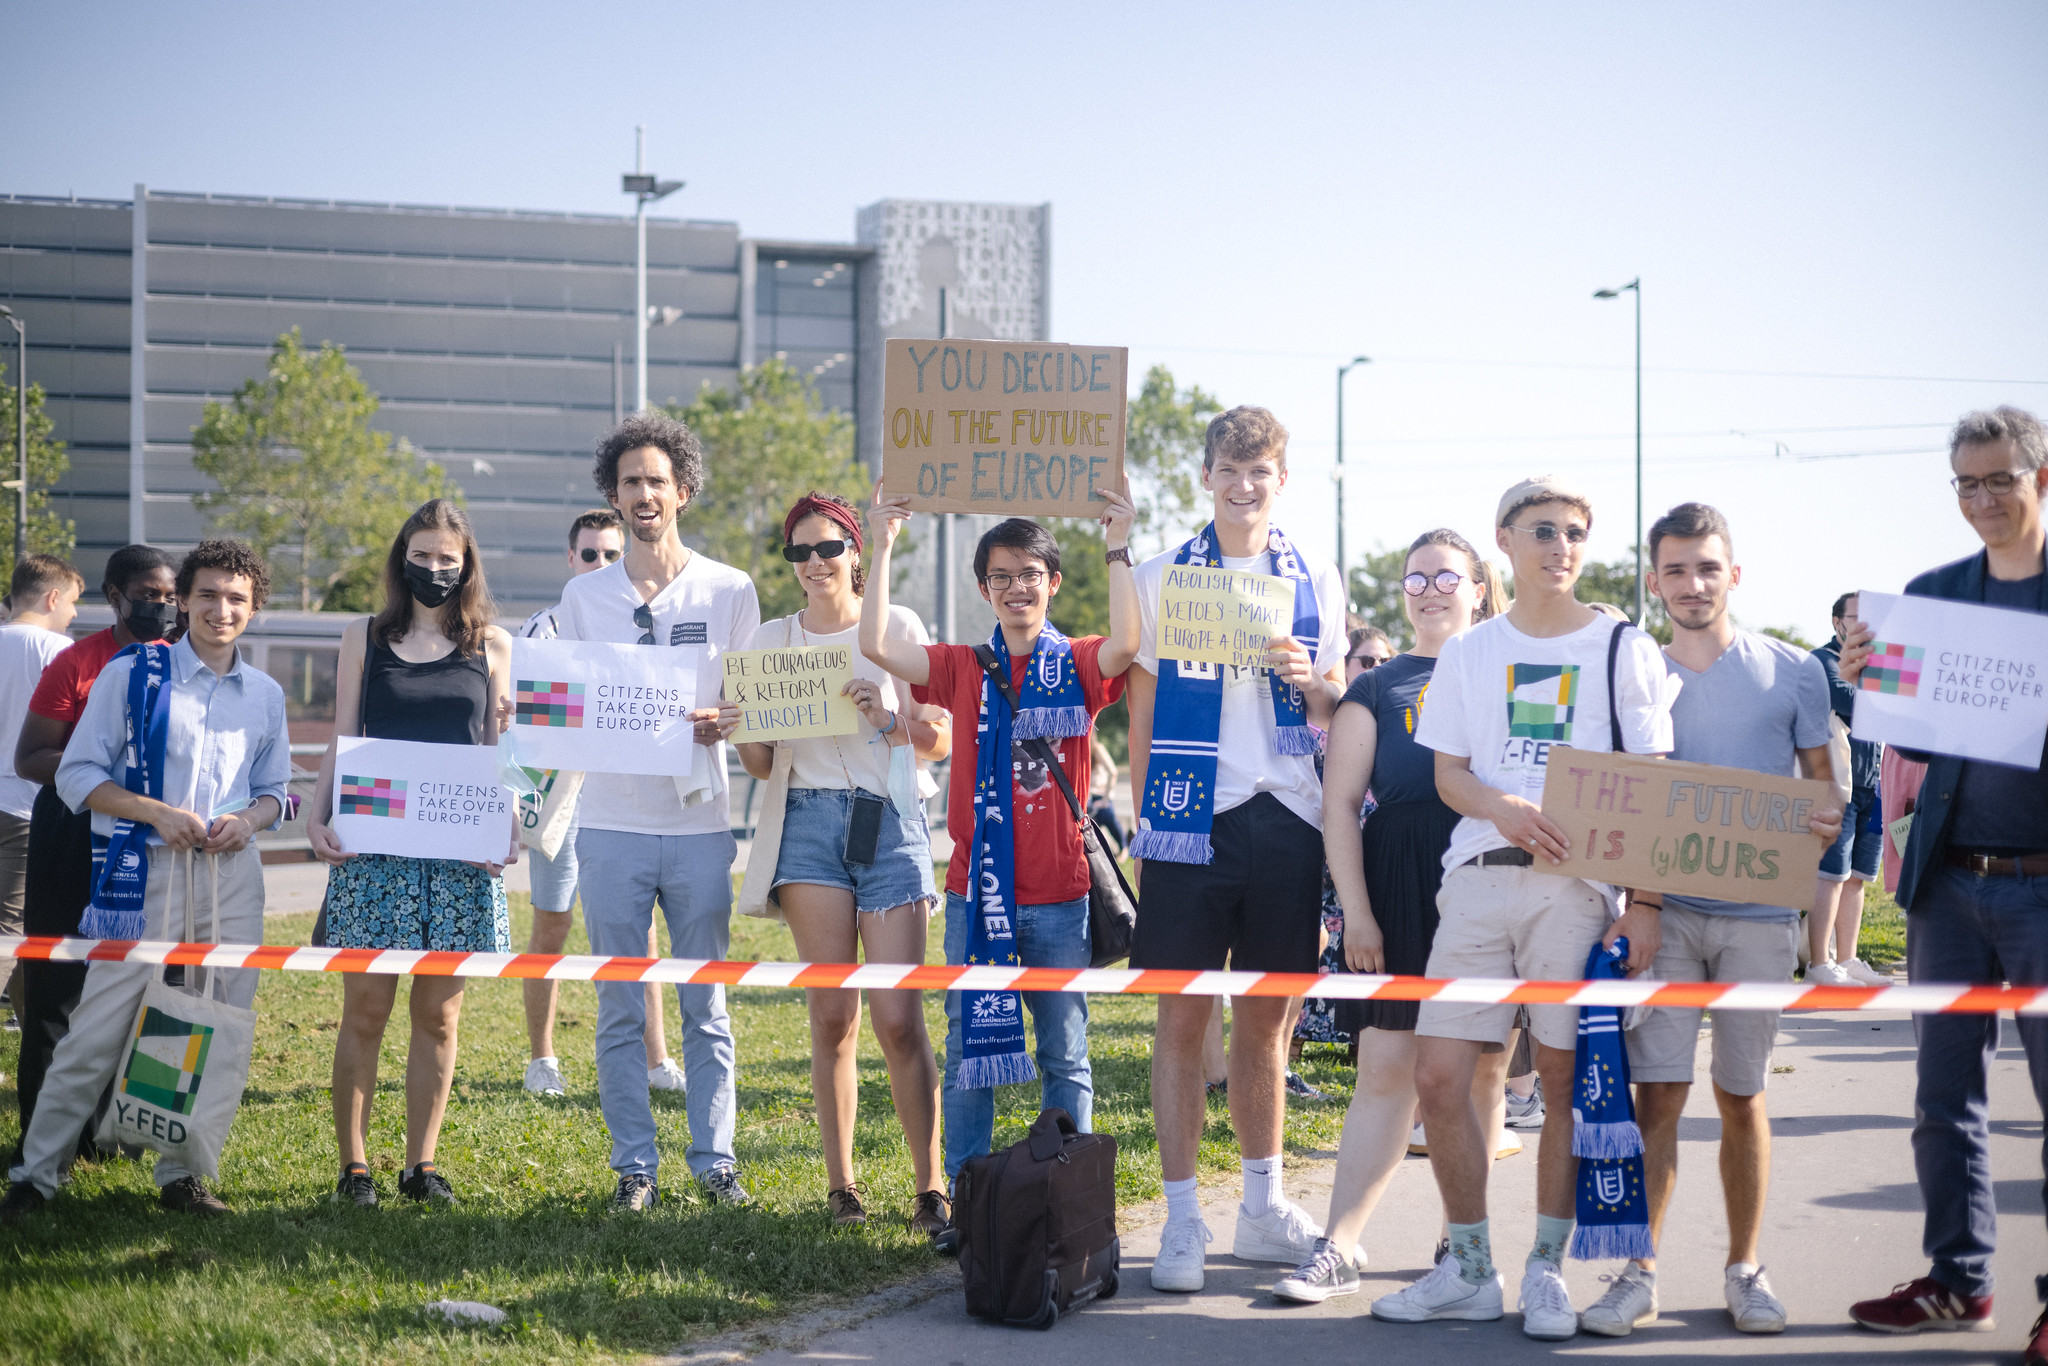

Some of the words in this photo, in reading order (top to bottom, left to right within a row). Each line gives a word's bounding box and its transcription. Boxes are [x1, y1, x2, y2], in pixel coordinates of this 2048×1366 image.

[908, 346, 987, 393] YOU
[1002, 351, 1111, 394] DECIDE
[891, 407, 934, 449] ON
[948, 409, 1001, 444] THE
[1011, 409, 1112, 446] FUTURE
[917, 462, 958, 498] OF
[970, 451, 1108, 502] EUROPE
[1166, 569, 1233, 594] ABOLISH
[1240, 577, 1272, 597] THE
[1165, 599, 1224, 623] VETOES
[1238, 602, 1287, 625] MAKE
[1164, 625, 1215, 651] EUROPE
[1219, 634, 1230, 651] A
[726, 657, 751, 676] BE
[762, 650, 847, 676] COURAGEOUS
[1939, 651, 2036, 679] CITIZENS
[597, 684, 679, 701] CITIZENS
[734, 681, 748, 703] &
[753, 677, 827, 702] REFORM
[1935, 668, 1985, 689] TAKE
[1990, 677, 2044, 698] OVER
[596, 700, 637, 715] TAKE
[642, 703, 686, 718] OVER
[1932, 686, 2010, 712] EUROPE
[596, 716, 661, 732] EUROPE
[744, 700, 828, 731] EUROPE!
[419, 782, 498, 799] CITIZENS
[1568, 766, 1648, 814] THE
[1666, 780, 1814, 834] FUTURE
[418, 796, 457, 810] TAKE
[462, 799, 506, 813] OVER
[417, 810, 481, 826] EUROPE
[1585, 829, 1625, 860] IS
[1650, 832, 1780, 880] (y)OURS
[116, 1099, 187, 1144] Y-FED
